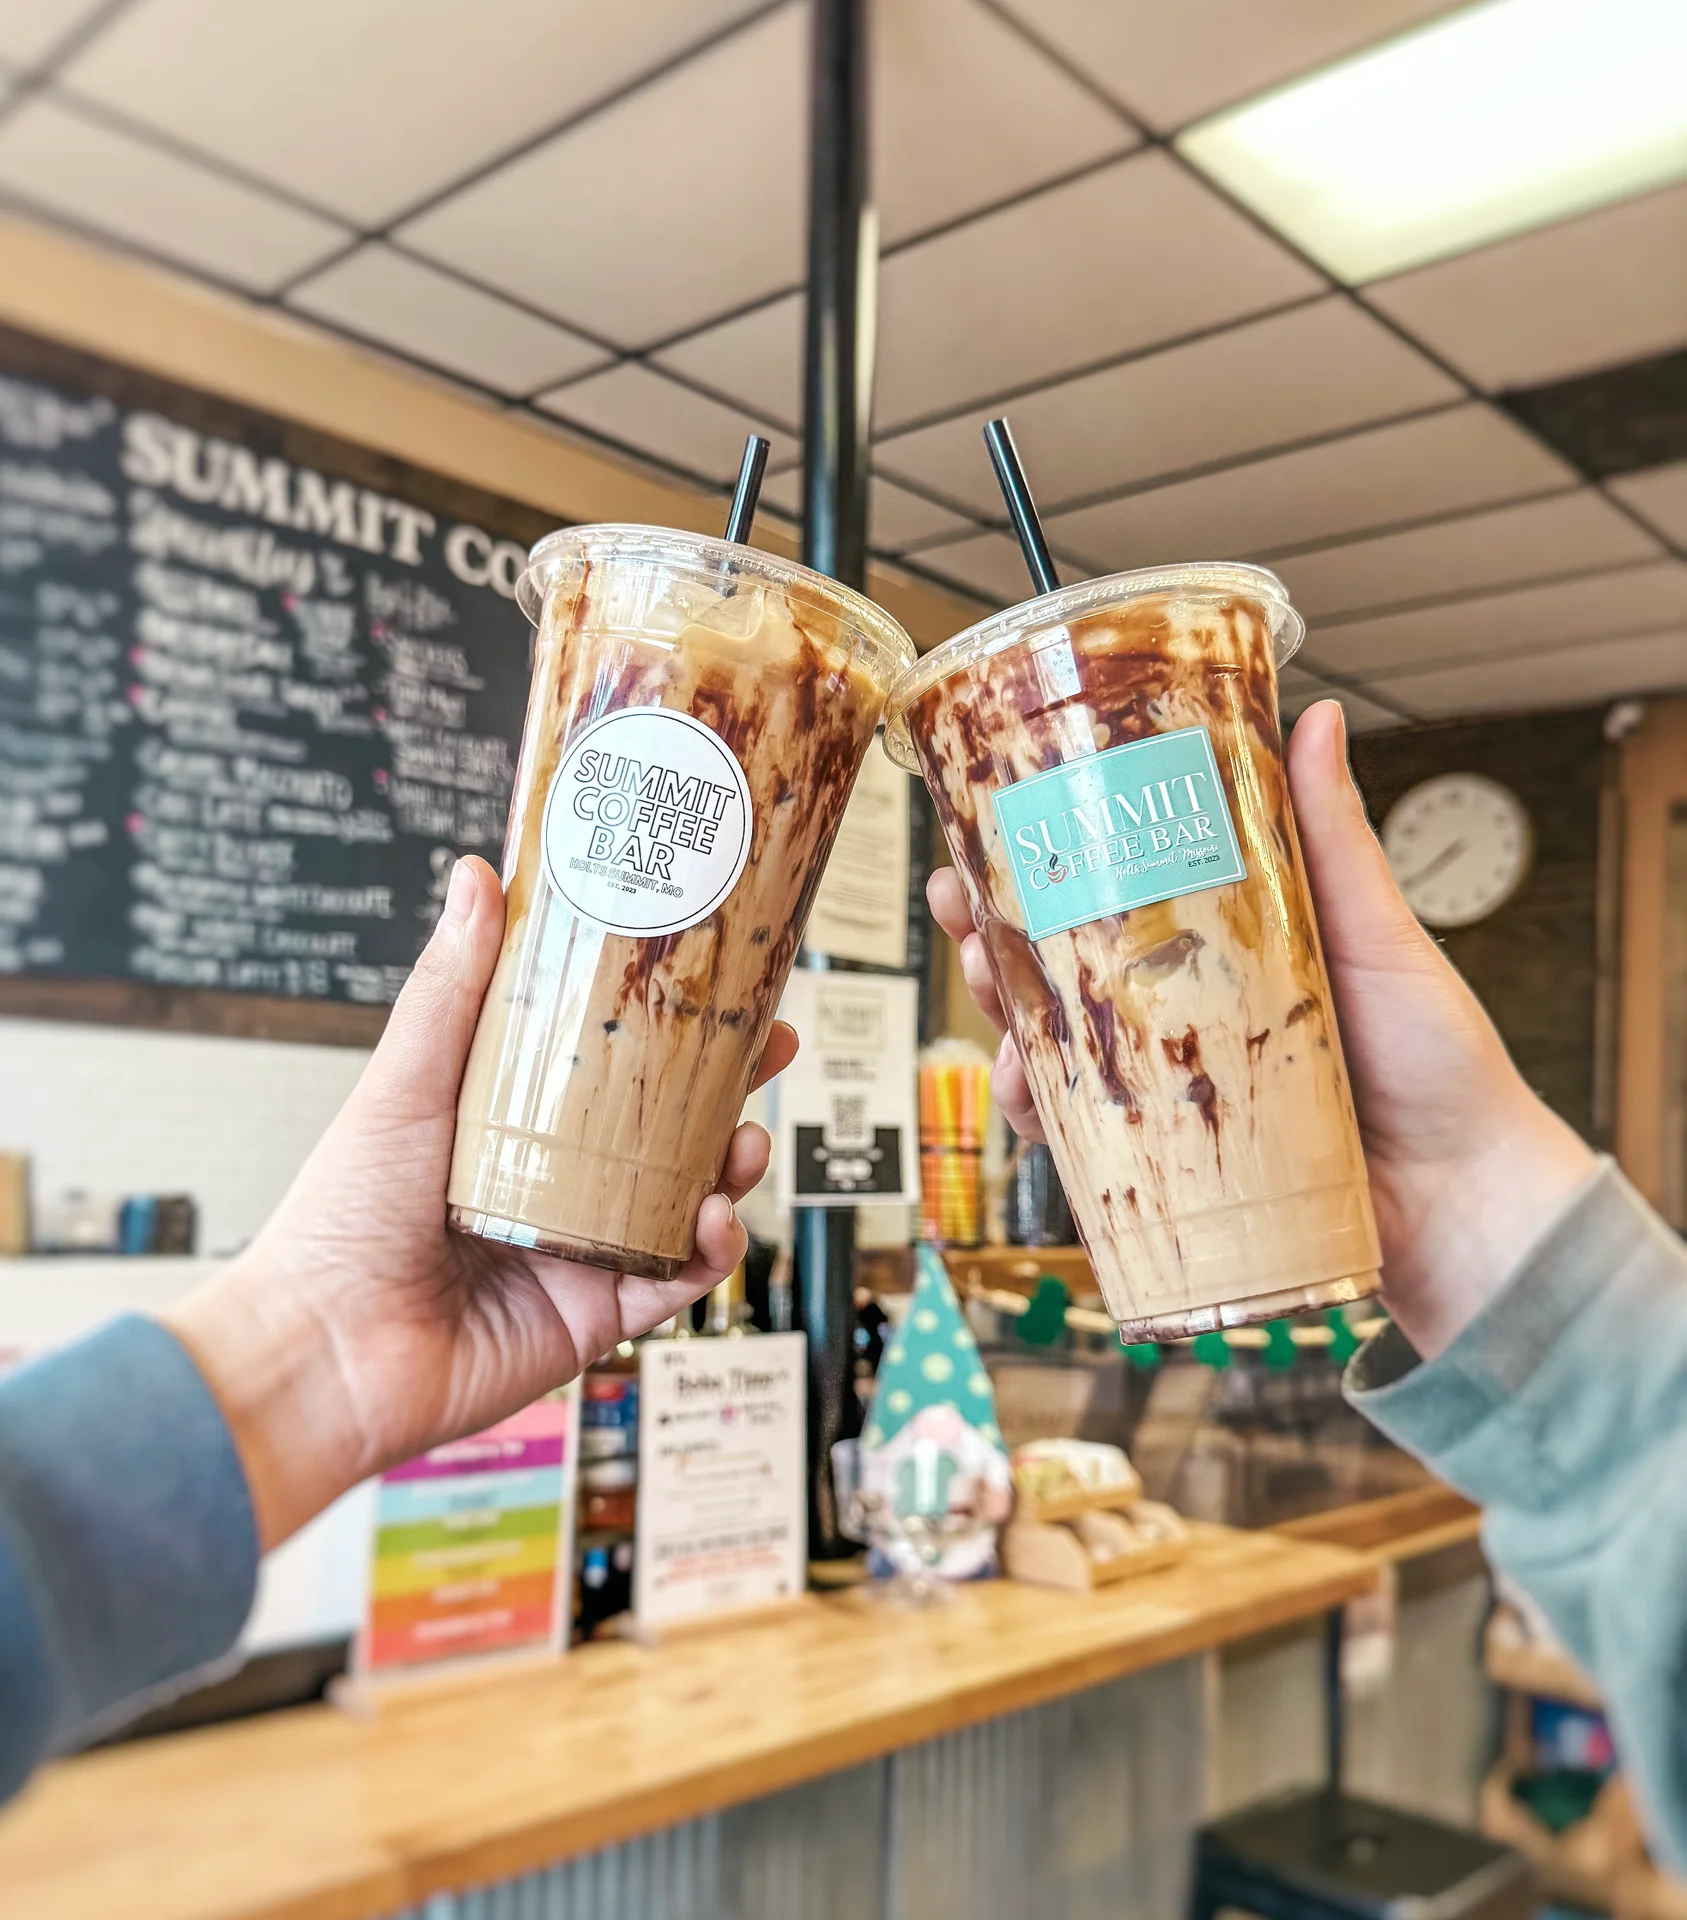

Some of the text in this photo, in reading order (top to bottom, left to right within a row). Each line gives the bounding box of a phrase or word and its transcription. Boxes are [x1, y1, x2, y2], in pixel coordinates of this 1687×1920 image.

[120, 412, 435, 567] SUMMIT
[573, 749, 737, 821] SUMMIT
[573, 786, 719, 855] COFFEE
[1015, 772, 1207, 865] SUMMIT
[1150, 815, 1219, 853] BAR
[587, 826, 675, 881] BAR
[1114, 861, 1141, 881] Holts
[1188, 854, 1221, 868] EST. 2023
[568, 857, 684, 899] HOLTS SUMMIT, MO
[607, 881, 637, 895] EST. 2023
